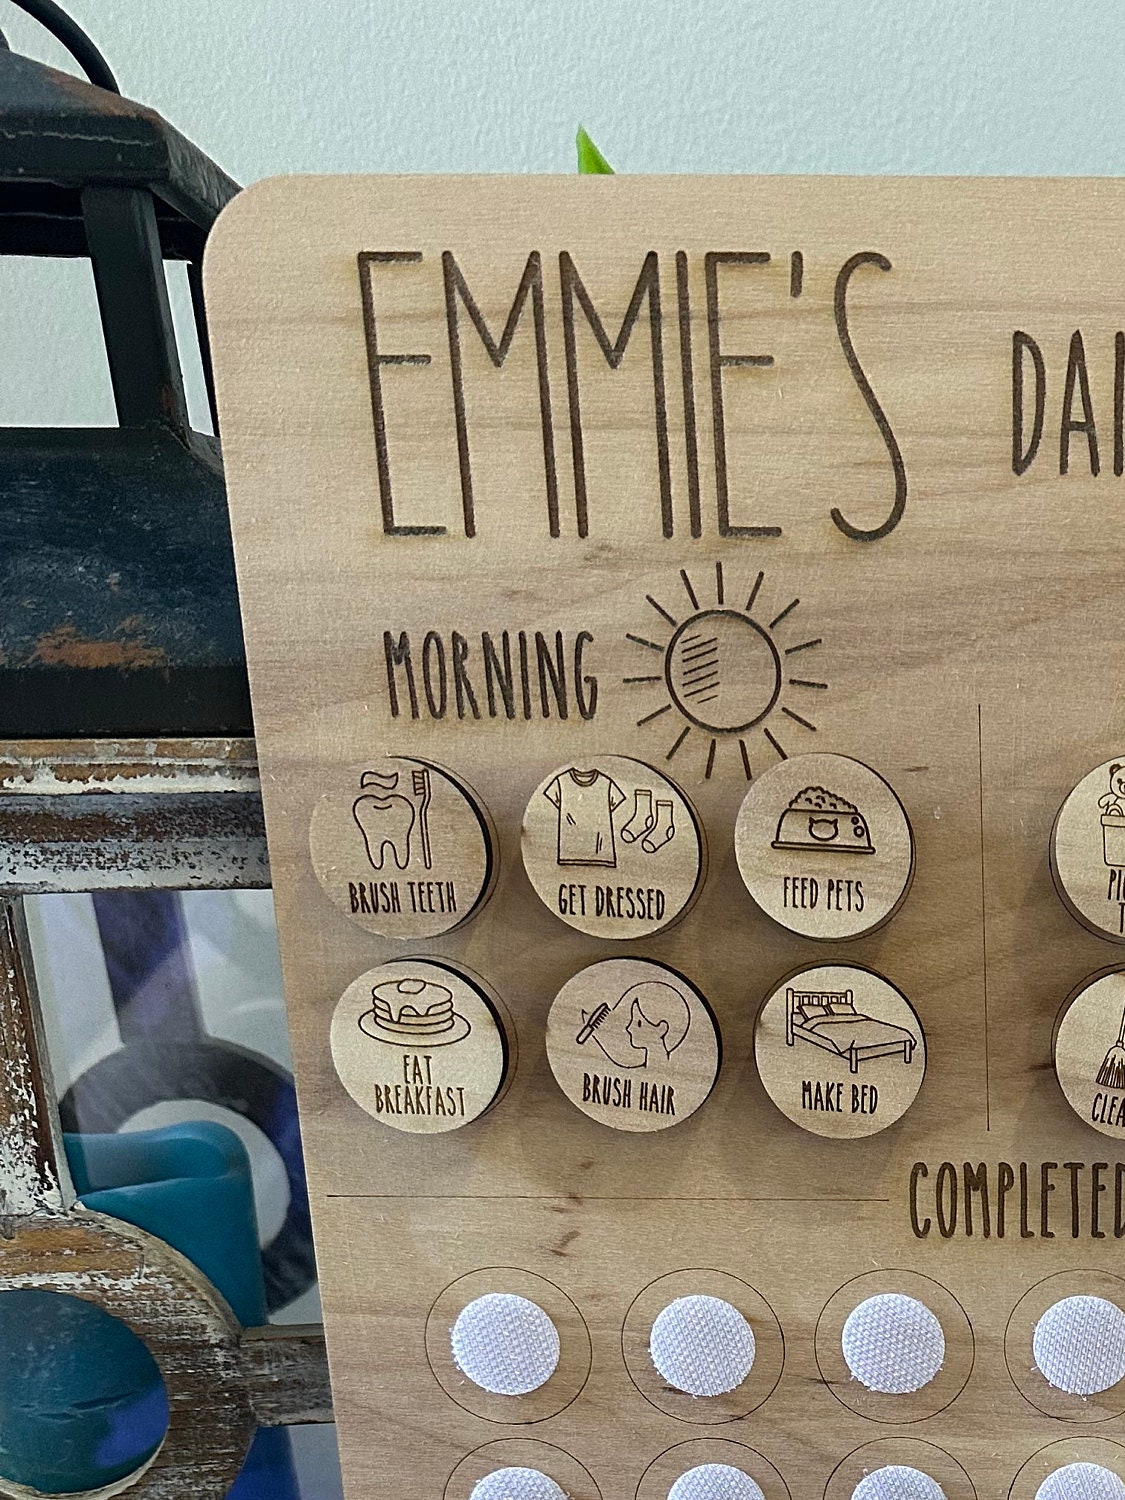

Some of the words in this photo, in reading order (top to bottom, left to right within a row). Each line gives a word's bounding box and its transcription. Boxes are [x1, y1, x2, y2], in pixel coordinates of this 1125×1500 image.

[357, 250, 907, 542] EMMIE'S
[383, 630, 598, 720] MORNING
[348, 882, 401, 914] BRUSH
[408, 881, 458, 914] TEETH
[558, 884, 587, 917] GET
[595, 886, 666, 921] DRESSED
[782, 877, 819, 910] FEED
[827, 879, 865, 912] PETS
[402, 1054, 432, 1087] EAT
[373, 1084, 466, 1118] BREAKFAST
[582, 1073, 632, 1109] BRUSH
[640, 1080, 677, 1116] HAIR
[801, 1081, 845, 1113] MAKE
[850, 1082, 878, 1115] BED
